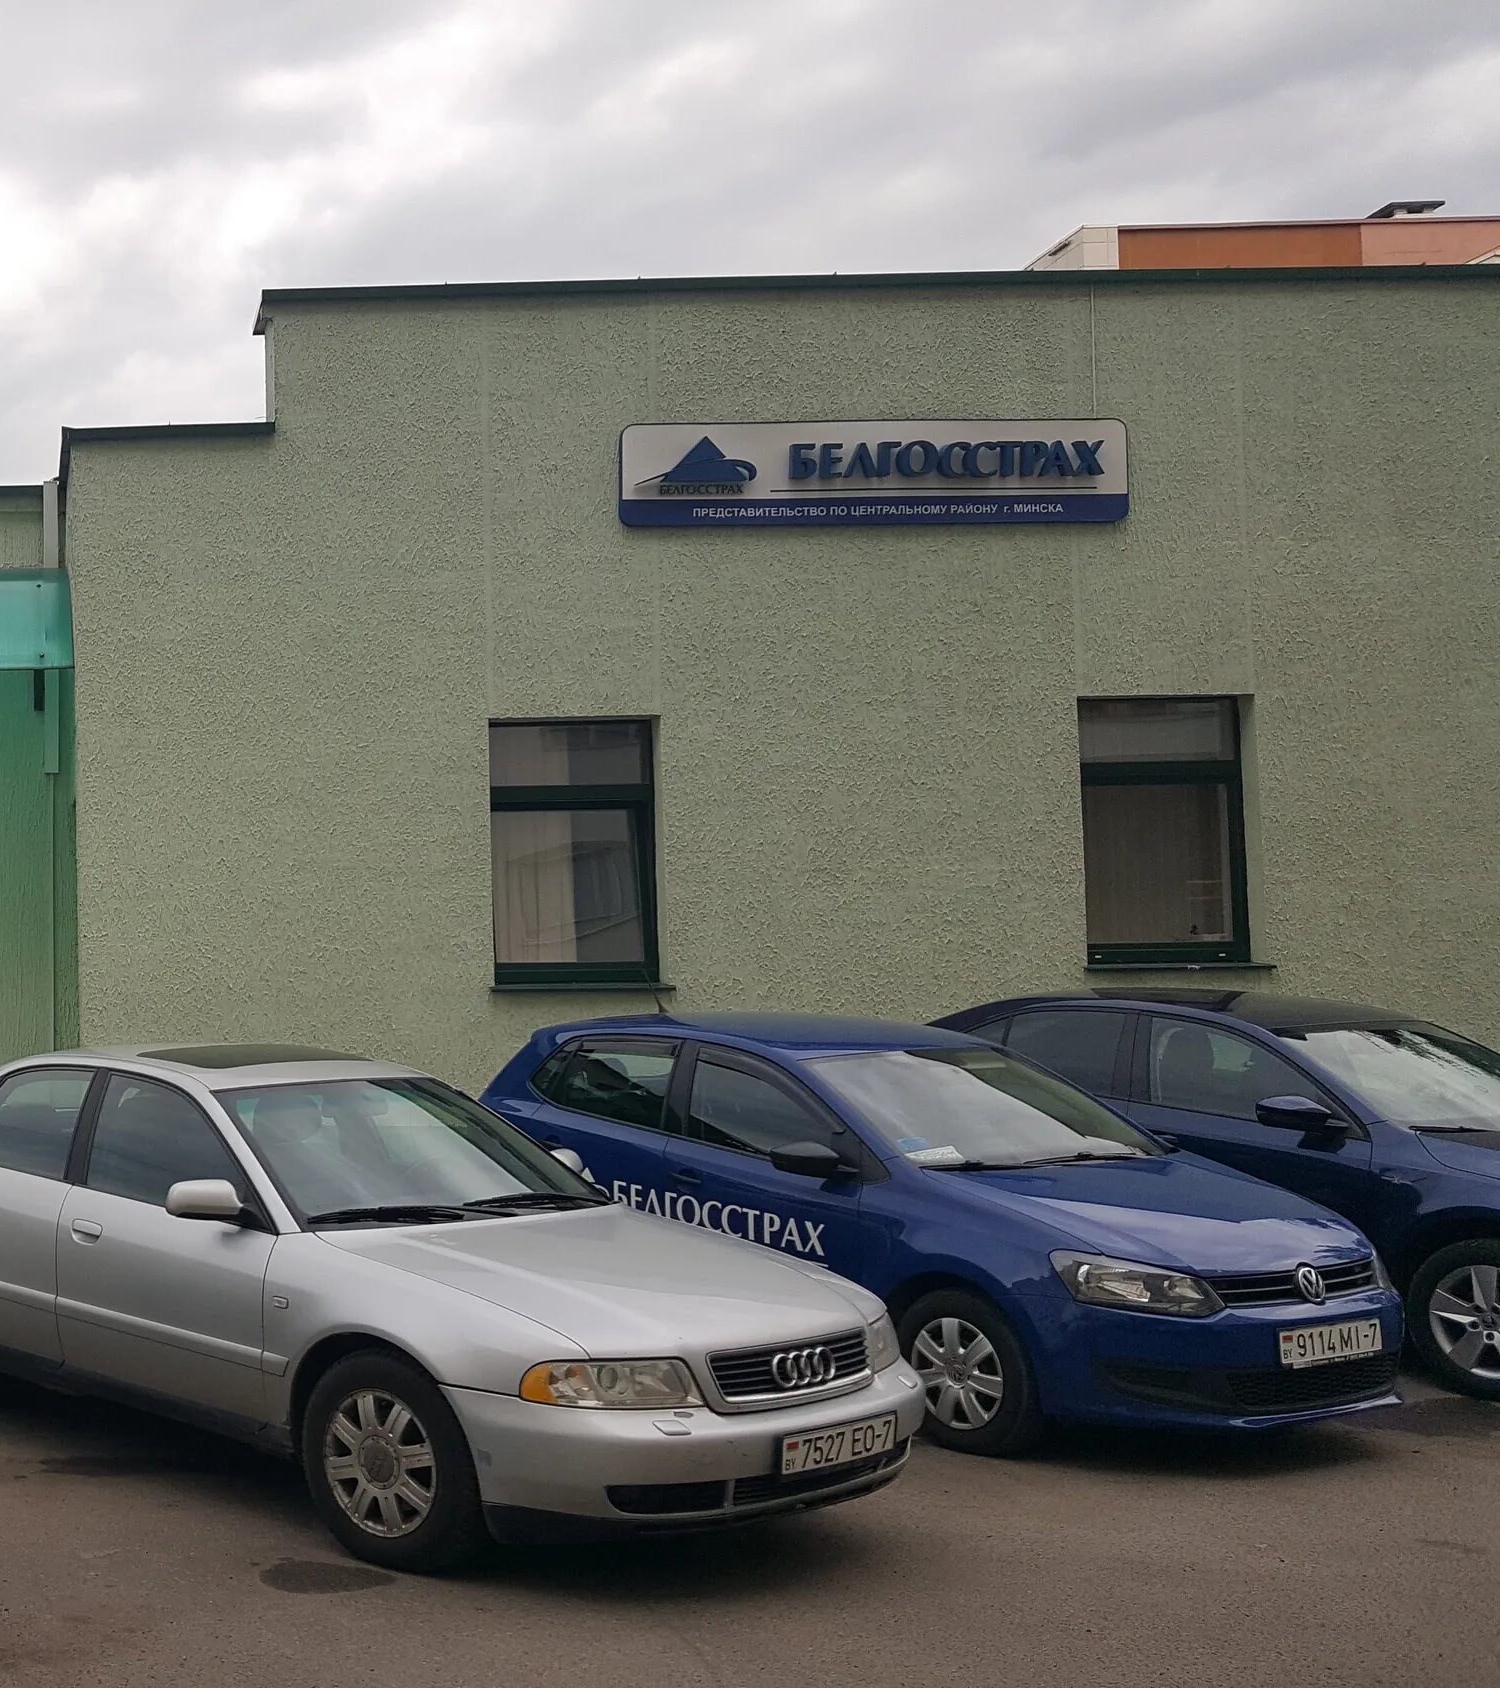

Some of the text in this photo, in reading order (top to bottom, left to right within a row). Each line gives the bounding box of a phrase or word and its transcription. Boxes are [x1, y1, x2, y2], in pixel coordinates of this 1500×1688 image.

[788, 440, 1105, 481] БЕЛГОССТРАХ
[660, 484, 744, 496] БЕЛГОССТРАХ
[693, 502, 1064, 518] ПРЕДСТАВИТЕЛЬСТВО ПО ЦЕНТРАЛЬНОМУ РАЙОНУ г. МИНСКА
[613, 1180, 825, 1256] БЕЛГОССТРАХ
[1283, 1349, 1293, 1359] BY
[802, 1419, 892, 1468] 7527 EO-7
[786, 1458, 796, 1471] BY
